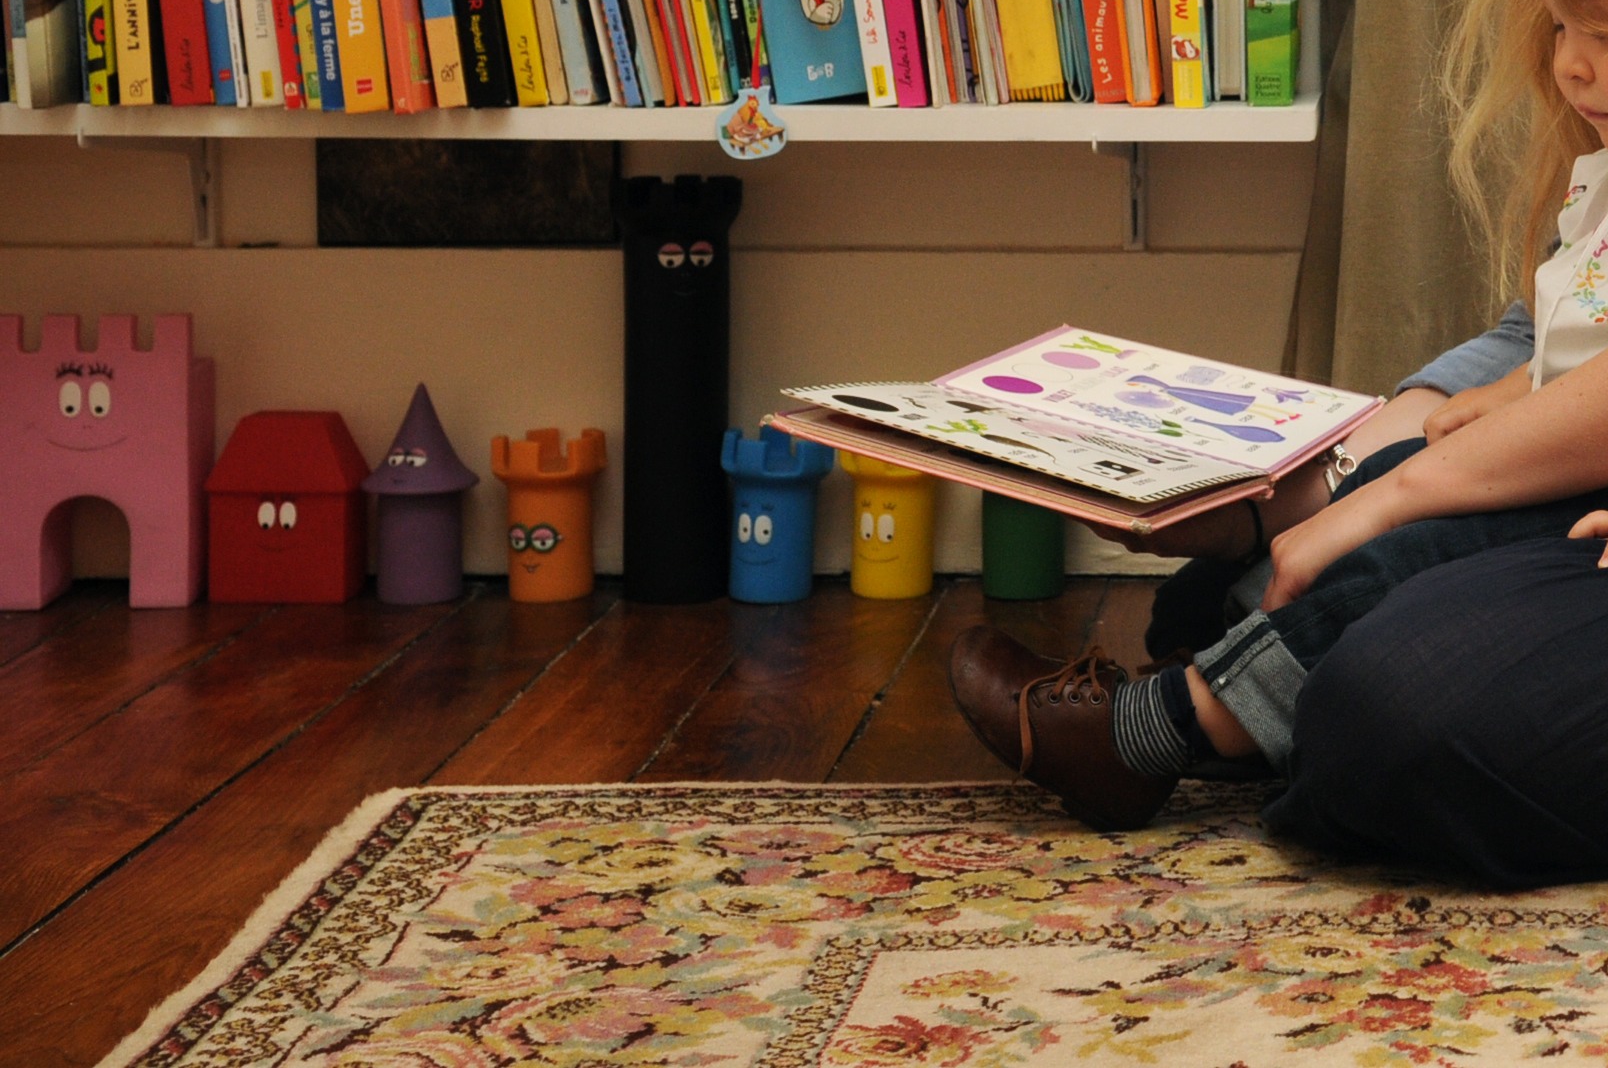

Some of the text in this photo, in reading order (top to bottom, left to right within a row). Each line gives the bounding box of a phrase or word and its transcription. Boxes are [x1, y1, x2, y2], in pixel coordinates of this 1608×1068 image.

[319, 8, 333, 19] à
[320, 21, 334, 35] la
[321, 38, 338, 81] ferme
[1093, 58, 1113, 84] Les
